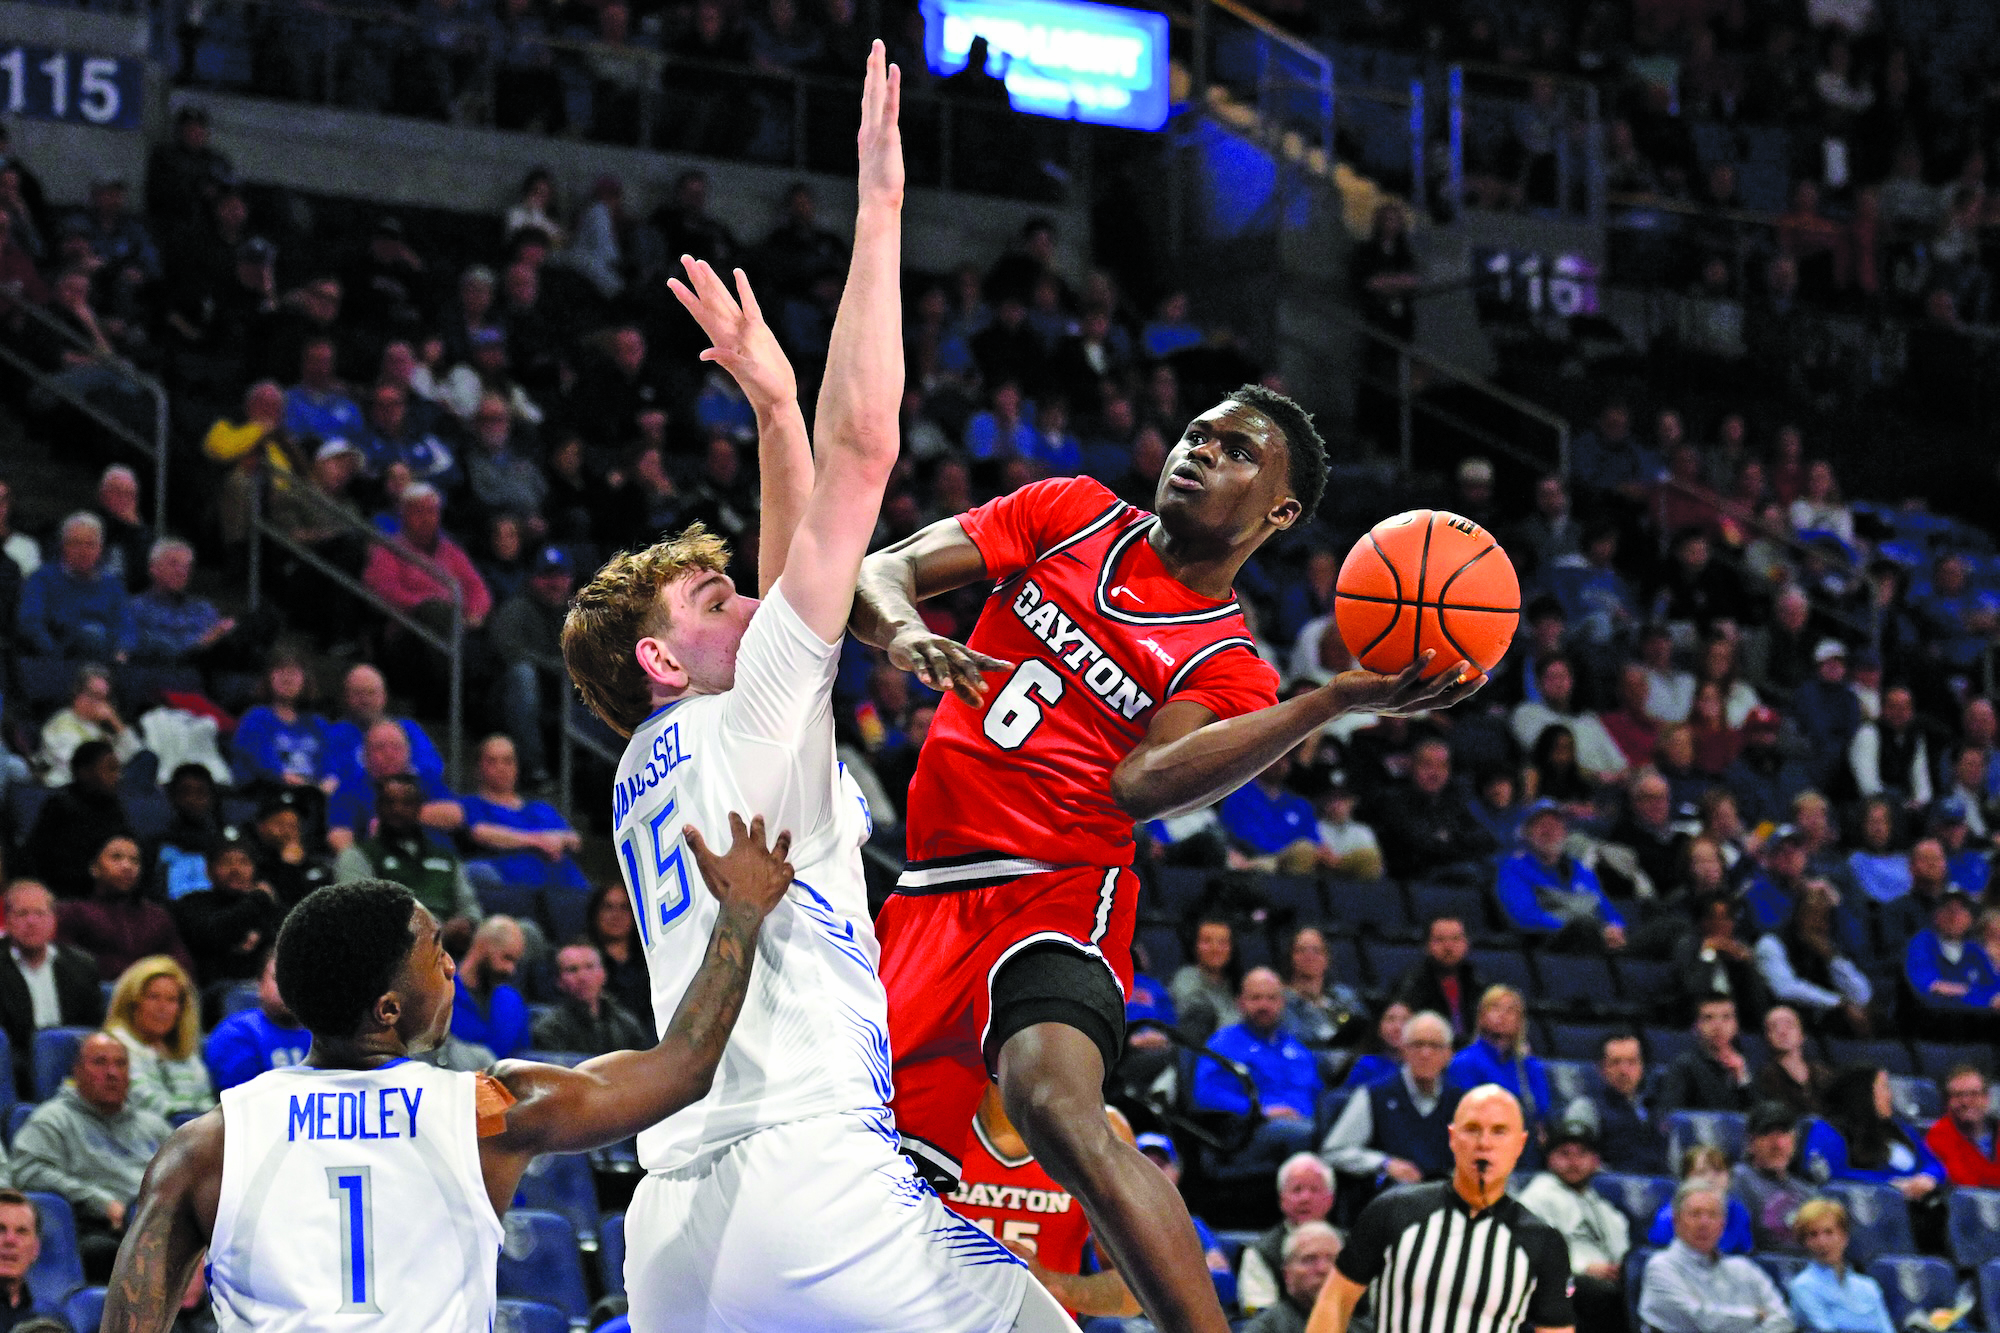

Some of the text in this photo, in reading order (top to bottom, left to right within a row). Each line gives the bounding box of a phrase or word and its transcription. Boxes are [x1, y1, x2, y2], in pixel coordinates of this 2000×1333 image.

[0, 47, 120, 124] 115
[1485, 253, 1583, 316] 116
[1011, 578, 1156, 722] DAYTON
[982, 656, 1066, 752] 6
[619, 785, 696, 954] 15
[288, 1087, 423, 1142] MEDLEY
[324, 1165, 384, 1315] 1
[947, 1179, 1073, 1215] DAYTON
